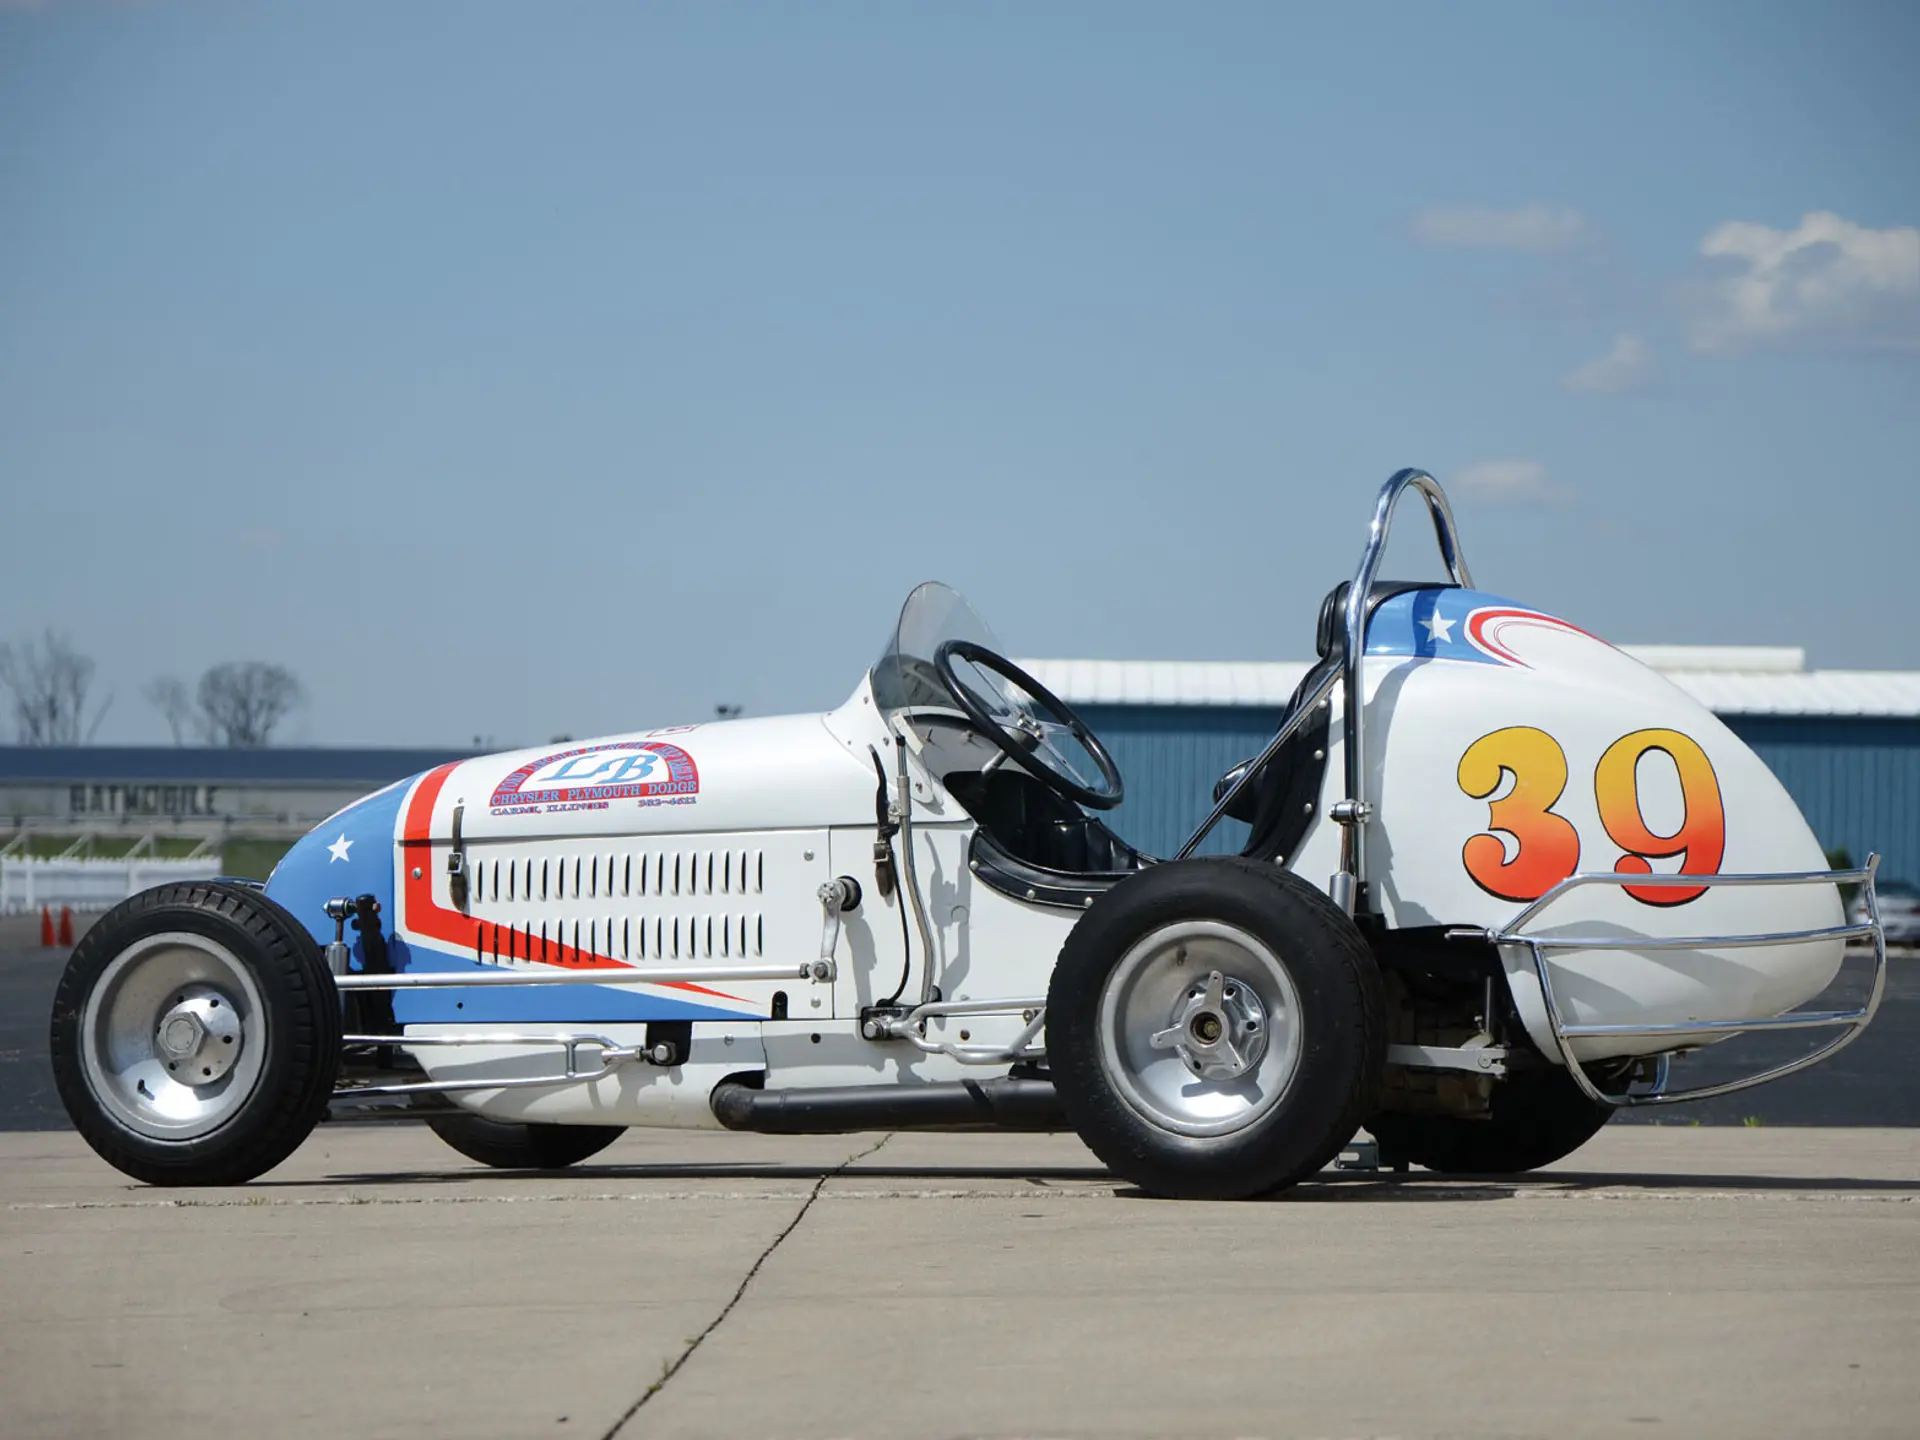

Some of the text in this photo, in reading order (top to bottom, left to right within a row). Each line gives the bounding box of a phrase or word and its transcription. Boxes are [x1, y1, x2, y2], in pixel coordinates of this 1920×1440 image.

[491, 780, 697, 806] CHRYSLER PLYMOUTH DODGE
[546, 802, 609, 813] ILLINOIS
[1457, 718, 1725, 908] 39
